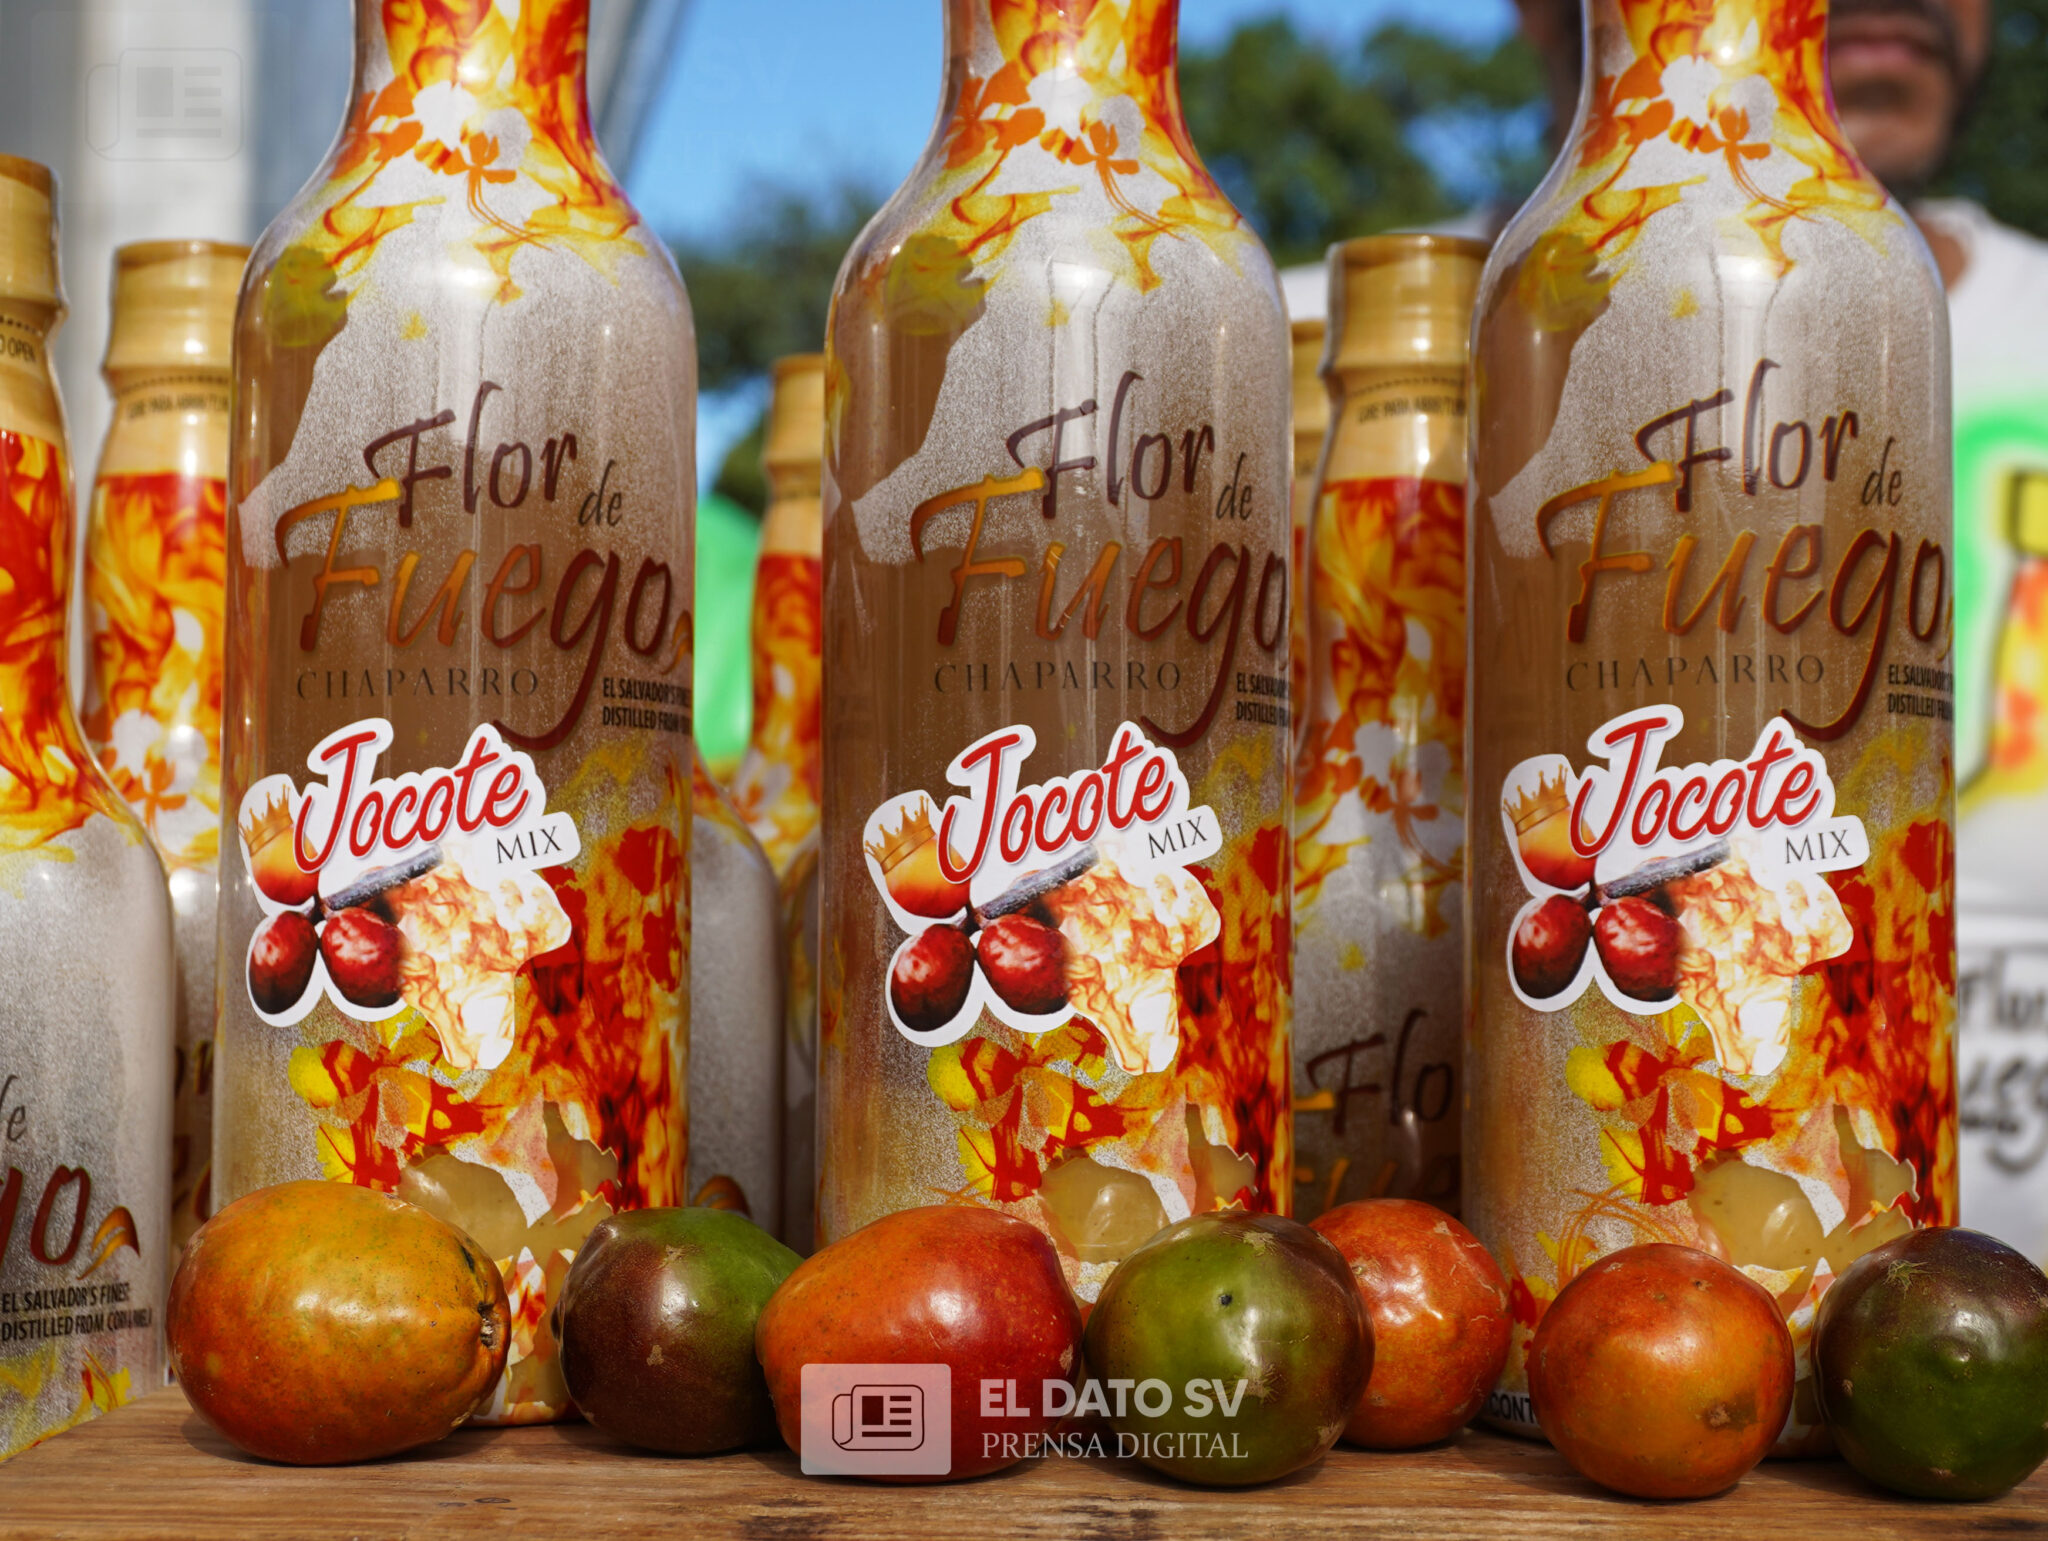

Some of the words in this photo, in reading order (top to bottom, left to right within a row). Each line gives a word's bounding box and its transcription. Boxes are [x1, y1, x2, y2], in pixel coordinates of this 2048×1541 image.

[363, 380, 578, 528] Flor
[577, 458, 623, 527] de
[1006, 370, 1213, 520] Flor
[1215, 452, 1254, 521] de
[1634, 357, 1859, 513] Flor
[1860, 436, 1903, 507] de
[274, 477, 674, 751] Fuego
[910, 466, 1288, 749] Fuego
[1536, 459, 1945, 743] Fuego
[296, 668, 539, 700] CHAPARRO
[603, 678, 617, 698] EL
[935, 660, 1181, 694] CHAPARRO
[1237, 672, 1247, 693] EL
[1566, 654, 1825, 692] CHAPARRO
[1888, 664, 1900, 685] EL
[602, 706, 657, 730] DISTILLED
[1888, 693, 1936, 718] DISTILLED
[295, 731, 529, 873] Jocote
[1570, 717, 1821, 856] Jocote
[937, 730, 1174, 883] Jocote
[496, 826, 562, 864] MIX
[1148, 816, 1207, 859] MIX
[1785, 829, 1852, 864] MIX
[2, 1292, 19, 1314] EL
[2, 1316, 73, 1342] DISTILLED
[75, 1312, 104, 1335] FROM
